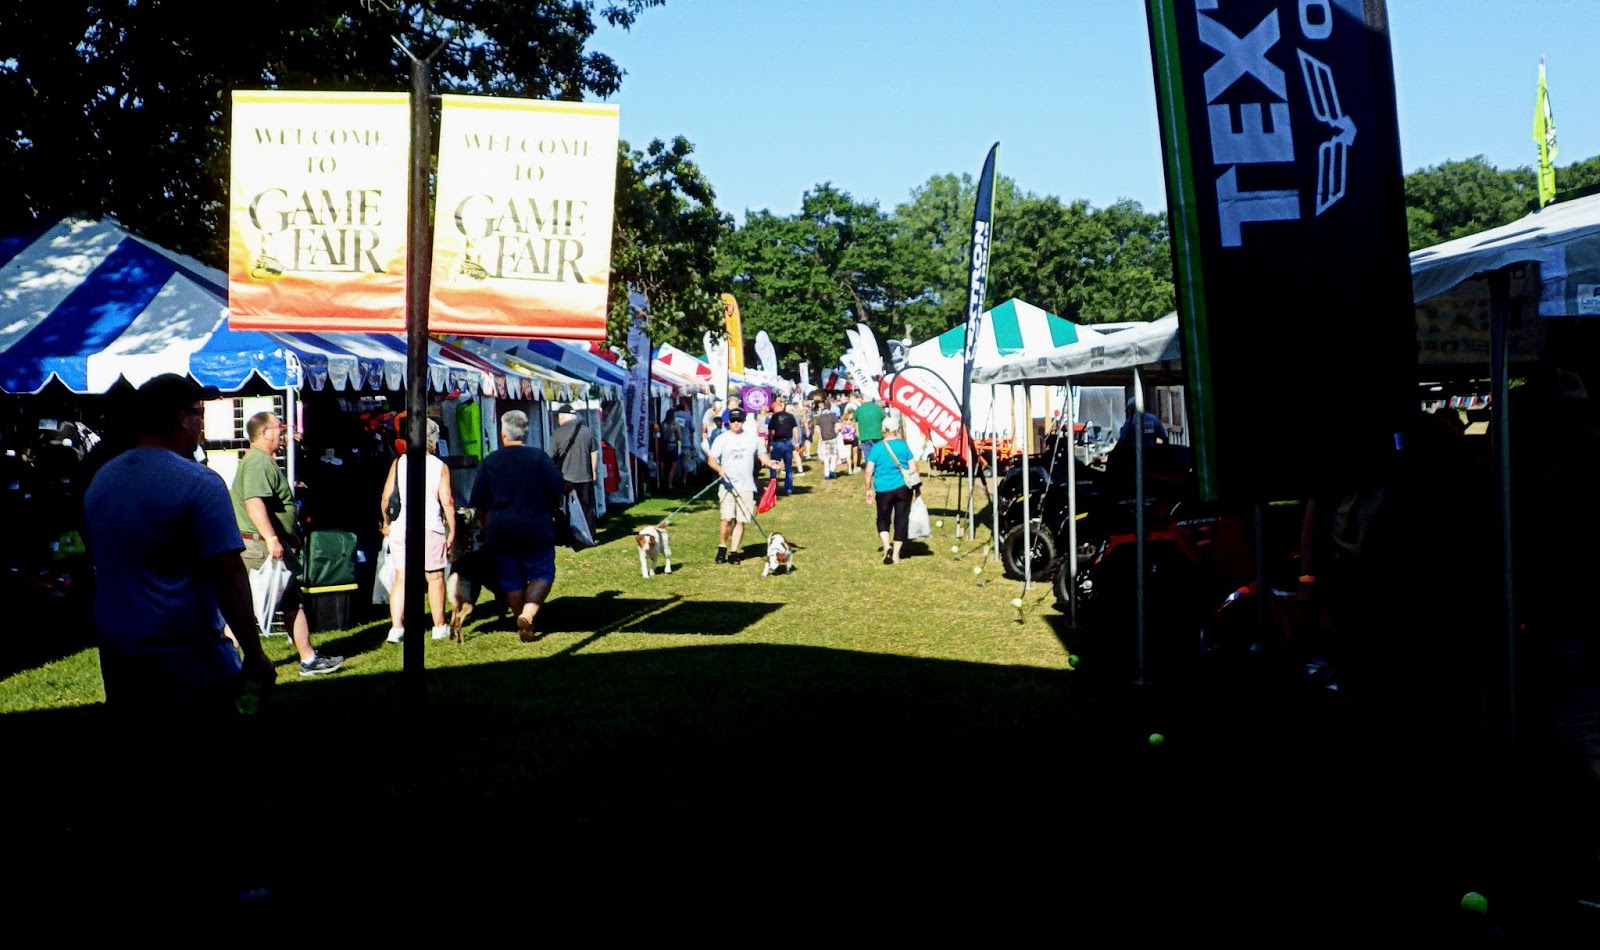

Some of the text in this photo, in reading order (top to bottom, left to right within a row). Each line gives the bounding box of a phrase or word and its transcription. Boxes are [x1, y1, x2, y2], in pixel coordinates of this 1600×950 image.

[254, 127, 388, 147] WELCOME
[465, 133, 597, 157] WELCOME
[1195, 0, 1301, 247] TEX
[307, 157, 337, 173] TO
[515, 165, 544, 181] TO
[249, 188, 382, 232] GAME
[454, 194, 587, 238] GAME
[286, 228, 386, 273] FAIR
[491, 235, 586, 283] FAIR
[965, 220, 986, 365] TEXTRON
[896, 385, 961, 439] CABINS
